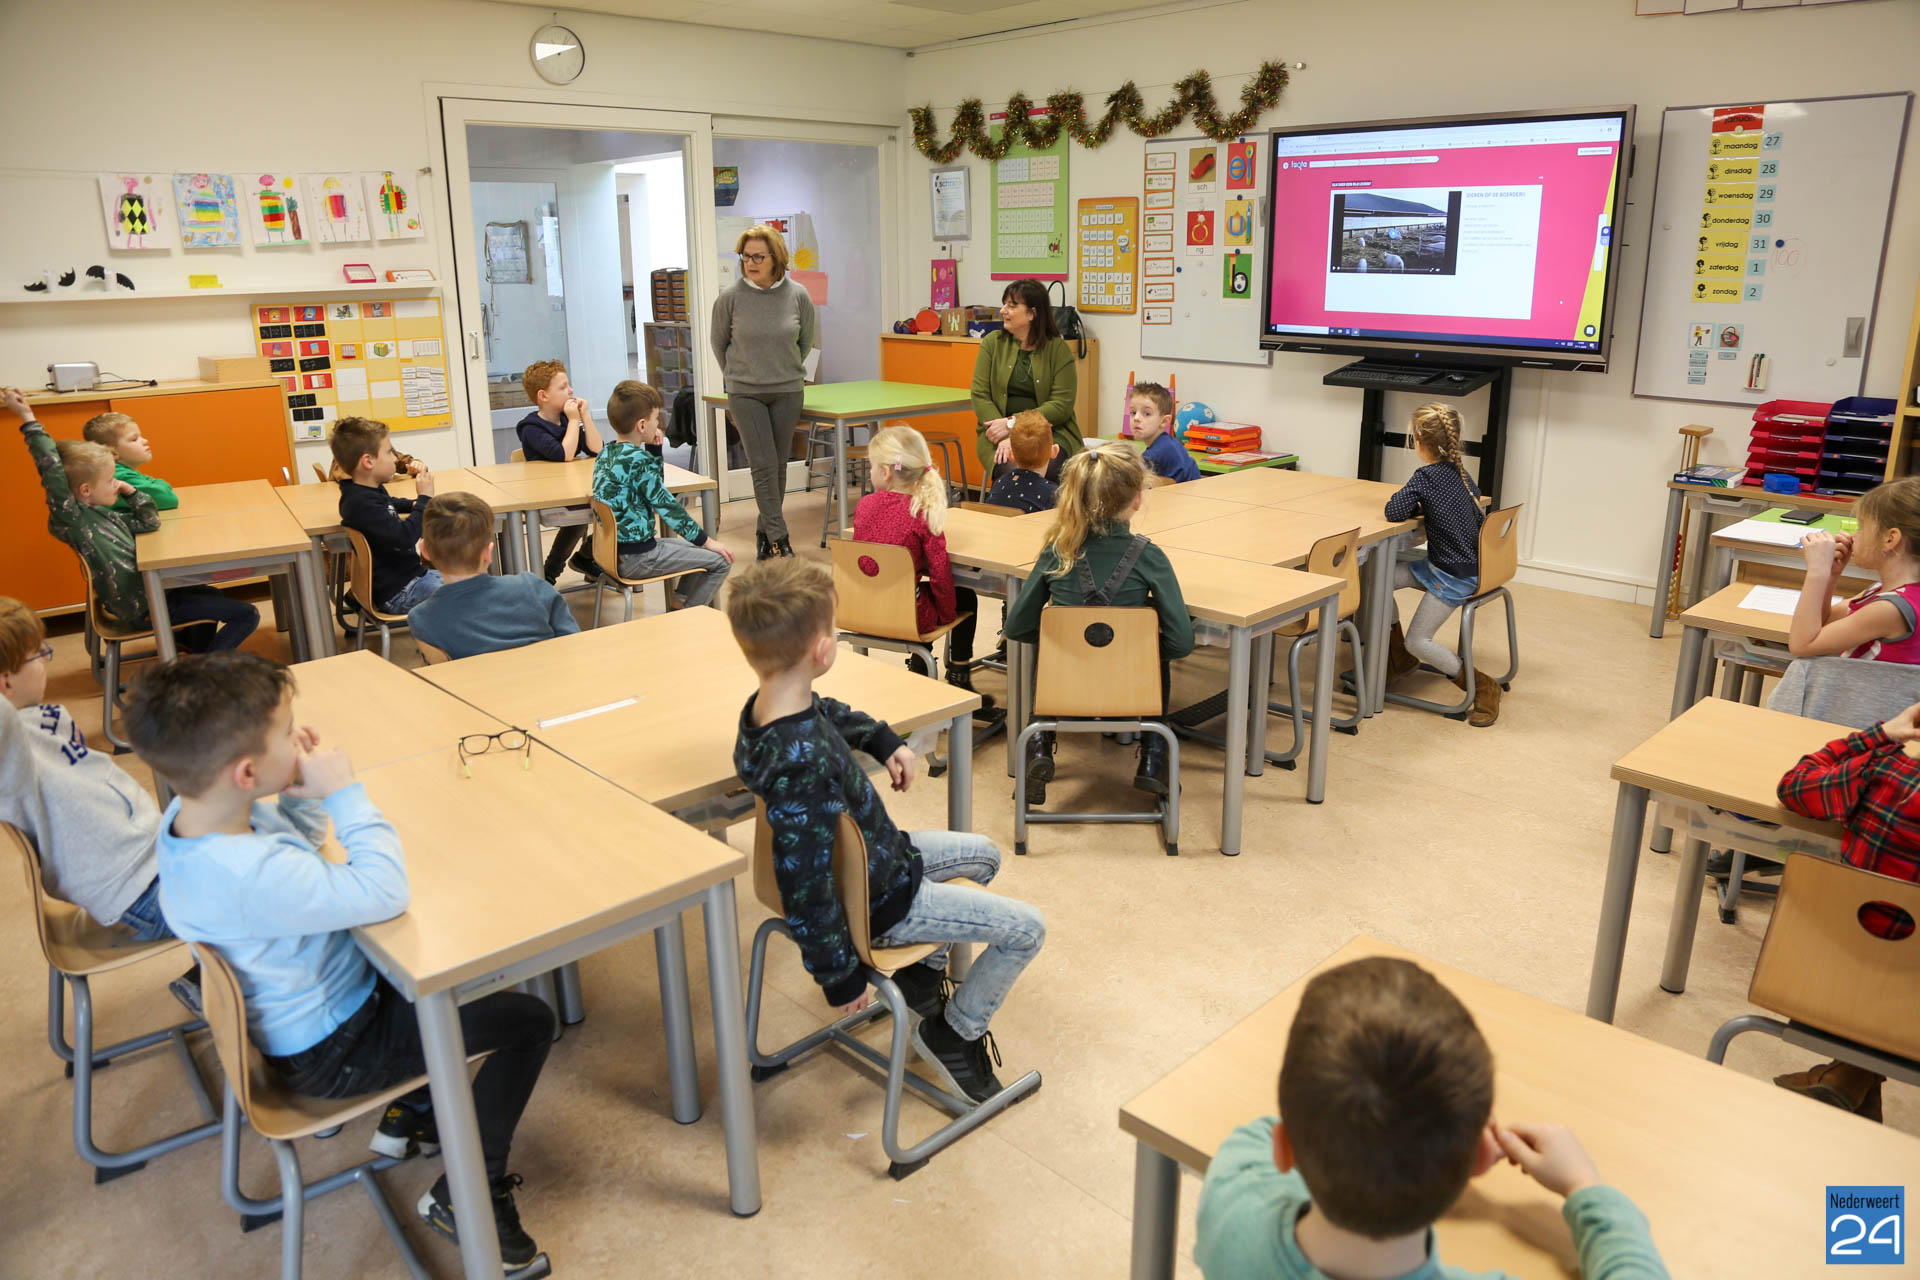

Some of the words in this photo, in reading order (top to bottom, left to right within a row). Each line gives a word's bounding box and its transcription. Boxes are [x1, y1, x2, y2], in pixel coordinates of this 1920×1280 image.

[1723, 141, 1758, 150] maandag
[1765, 136, 1780, 147] 27
[1724, 167, 1753, 175] dinsdag
[1762, 163, 1777, 174] 28
[1196, 183, 1208, 191] sch
[1718, 192, 1754, 200] woensdag
[1759, 188, 1774, 199] 29
[1711, 217, 1750, 225] donderdag
[1756, 213, 1771, 224] 30
[1715, 241, 1739, 249] vrijdag
[1752, 239, 1767, 249] 31
[1195, 247, 1204, 255] ng
[1709, 264, 1739, 272] zaterdag
[1753, 263, 1759, 273] 1
[1712, 288, 1738, 296] zondag
[1749, 287, 1757, 297] 2
